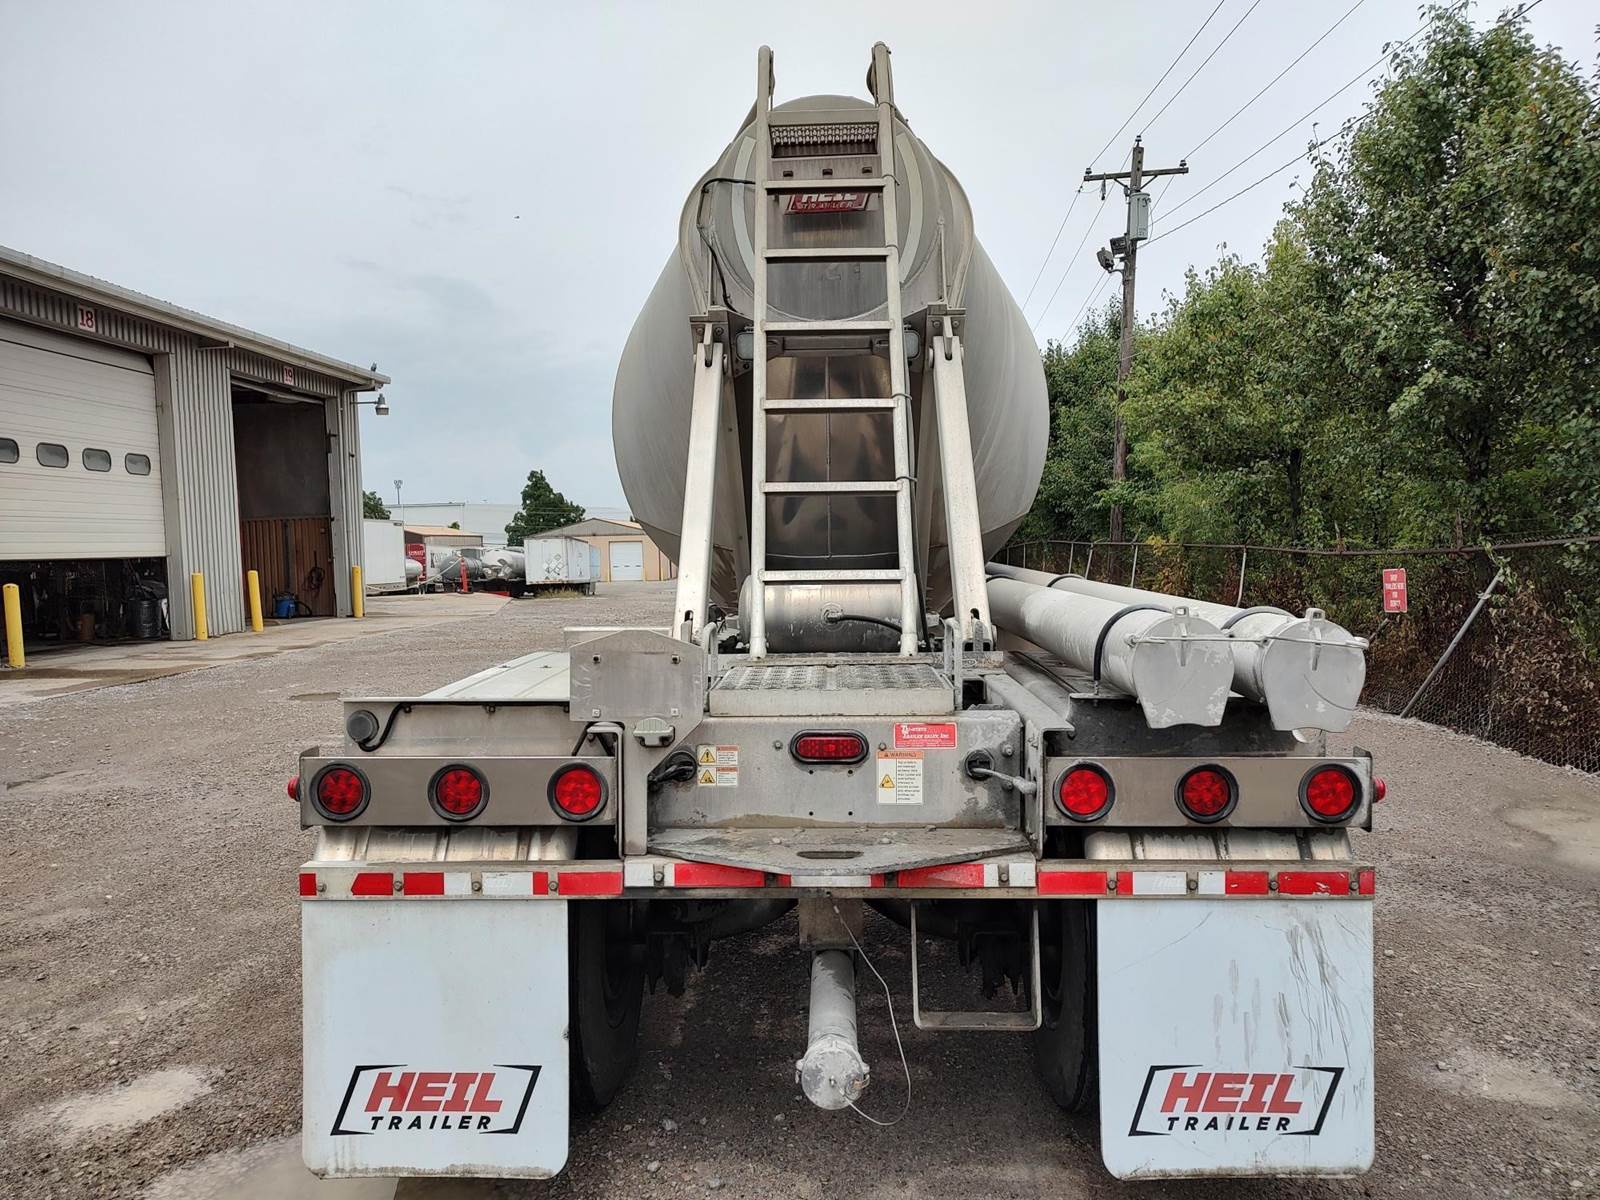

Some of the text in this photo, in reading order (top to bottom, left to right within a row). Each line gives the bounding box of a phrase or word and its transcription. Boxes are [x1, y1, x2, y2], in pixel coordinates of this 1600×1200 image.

[79, 307, 94, 329] 18
[284, 367, 293, 383] 19
[364, 1072, 503, 1112] HEIL
[1160, 1072, 1303, 1113] HEIL
[371, 1115, 492, 1130] TRAILER
[1167, 1116, 1291, 1131] TRAILER
